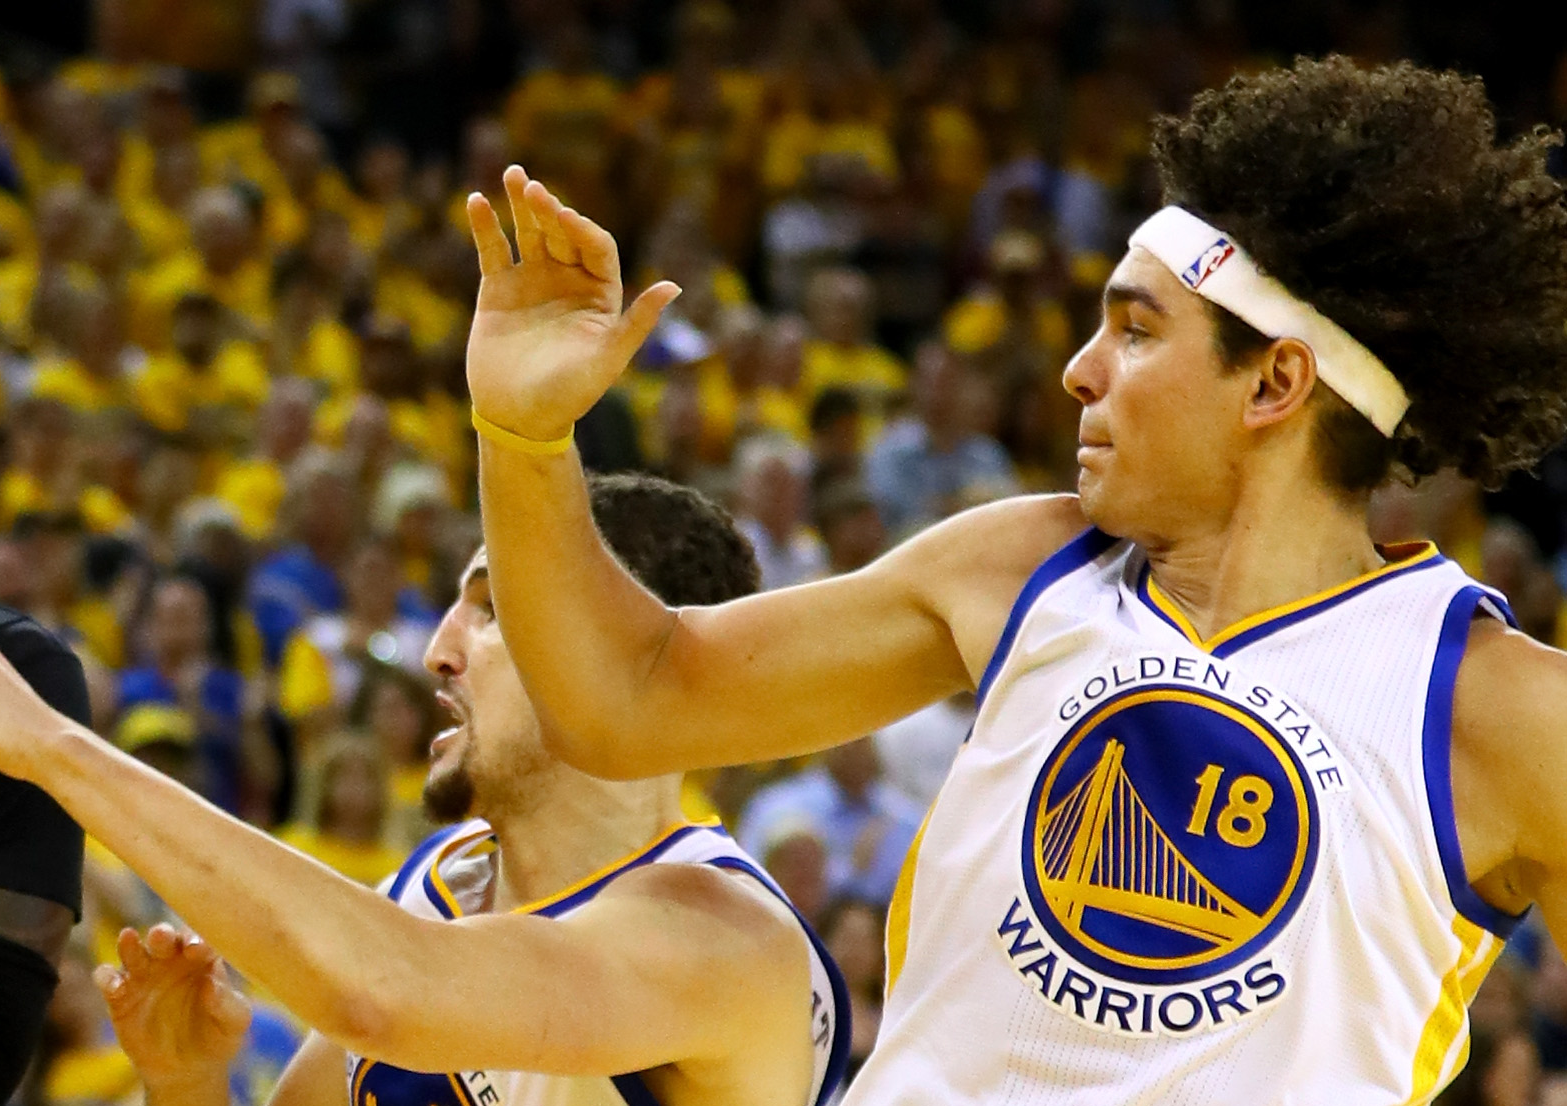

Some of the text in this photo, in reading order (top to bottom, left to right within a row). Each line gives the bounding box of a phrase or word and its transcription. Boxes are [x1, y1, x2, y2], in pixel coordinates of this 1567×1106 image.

[1059, 656, 1344, 790] GOLDEN STATE
[1186, 764, 1274, 848] 18
[997, 898, 1287, 1033] WARRIORS
